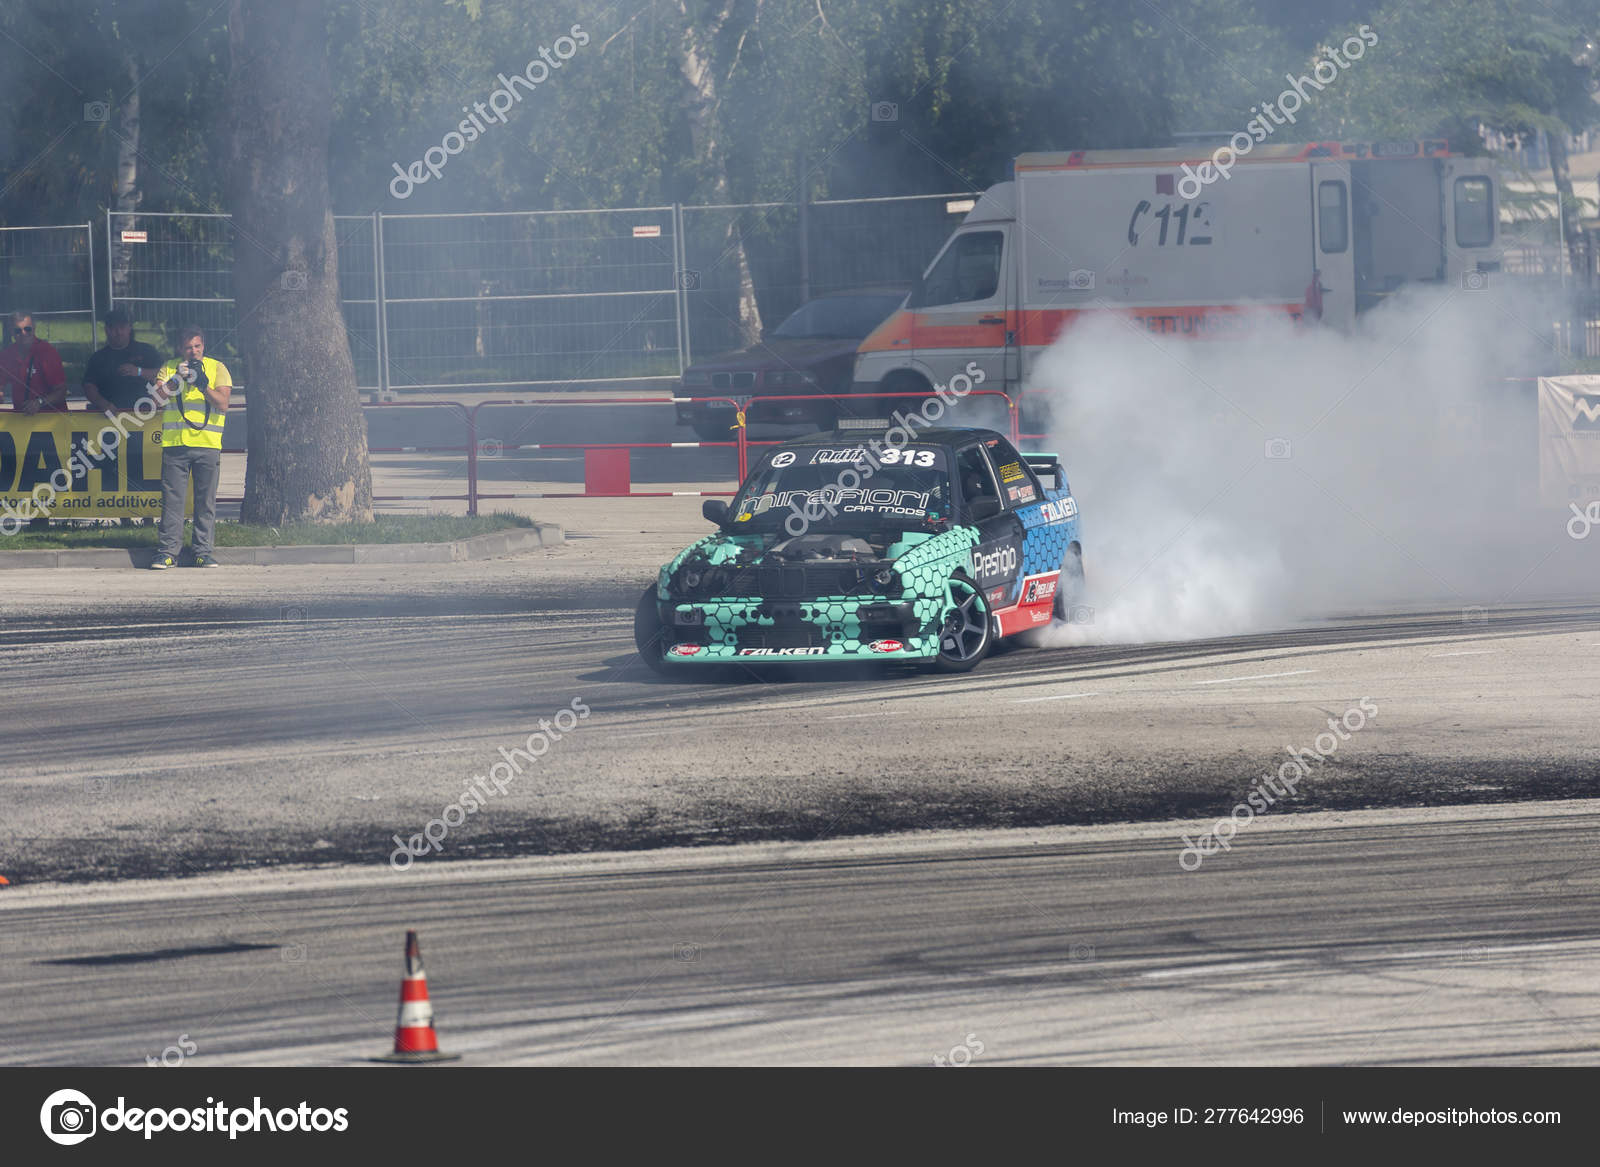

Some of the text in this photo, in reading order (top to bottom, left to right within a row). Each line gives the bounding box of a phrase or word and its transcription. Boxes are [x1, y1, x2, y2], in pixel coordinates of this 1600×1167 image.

[879, 448, 936, 467] 313
[63, 496, 91, 508] and
[97, 496, 163, 508] additives
[843, 505, 926, 517] CAR MODS
[1041, 497, 1078, 524] FALKEN
[974, 544, 1017, 581] Prestigio
[739, 646, 825, 656] FALKEN
